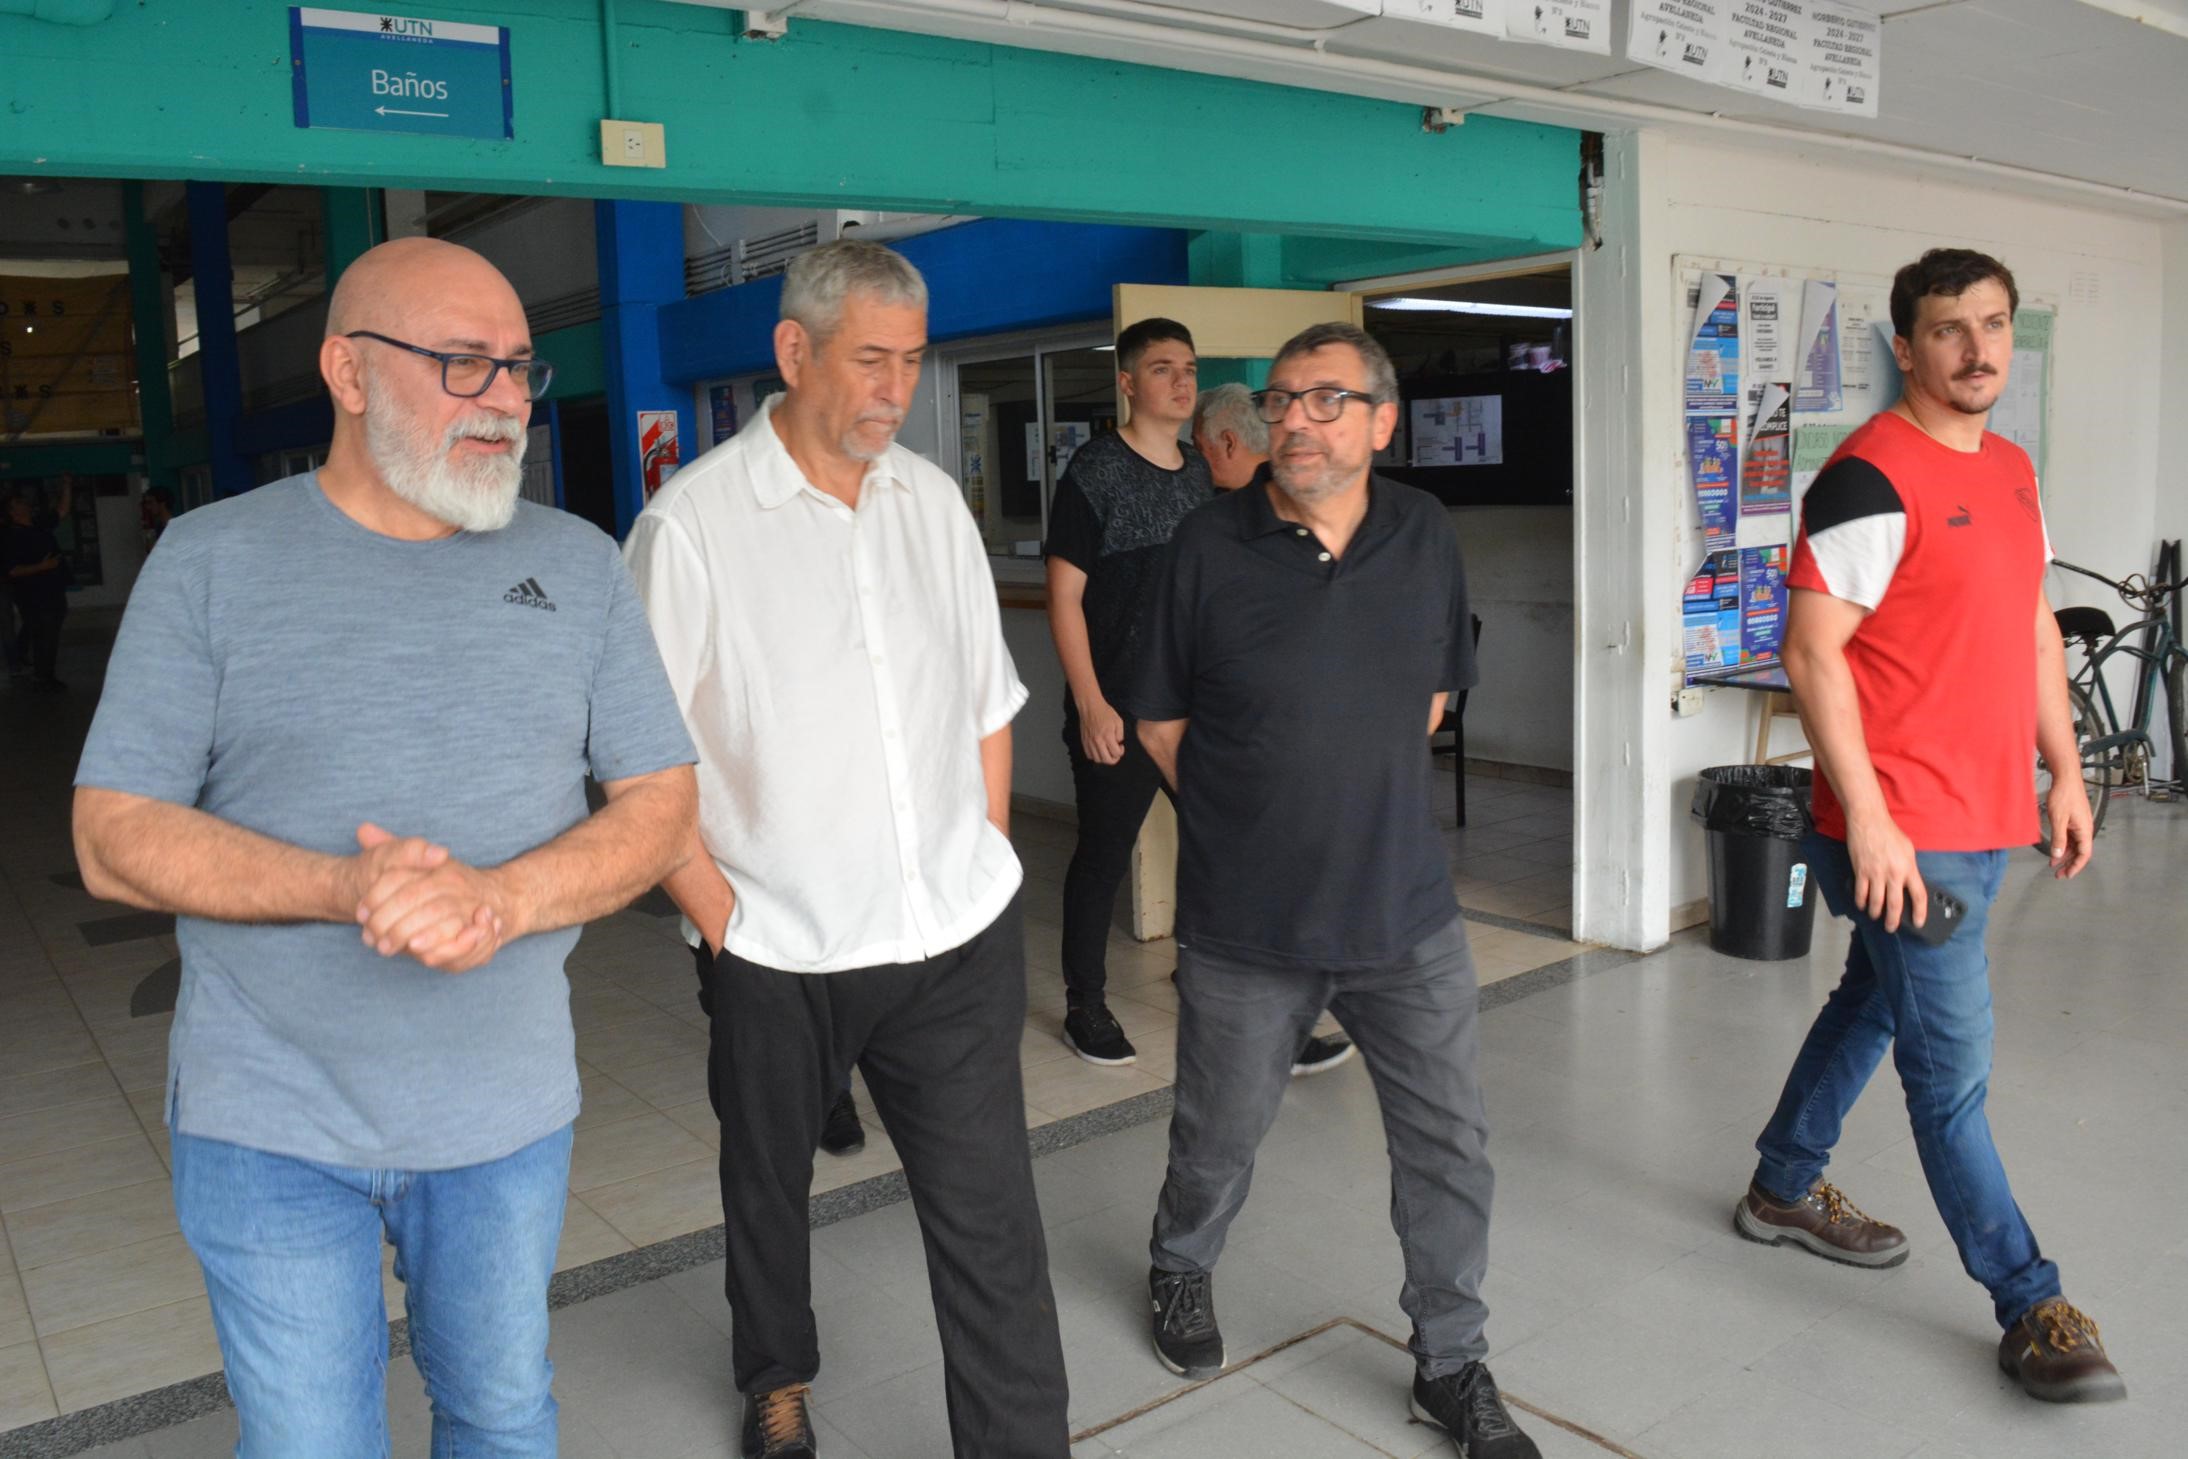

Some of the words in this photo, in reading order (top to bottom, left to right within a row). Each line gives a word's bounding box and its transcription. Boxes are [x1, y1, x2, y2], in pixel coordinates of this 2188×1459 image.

[1659, 2, 1704, 24] AVELLANEDA
[394, 18, 433, 36] UTN
[1731, 12, 1765, 30] FACULTAD
[1765, 23, 1798, 40] REGIONAL
[1743, 29, 1786, 49] AVELLANEDA
[371, 69, 449, 100] Baños
[503, 593, 557, 612] adidas
